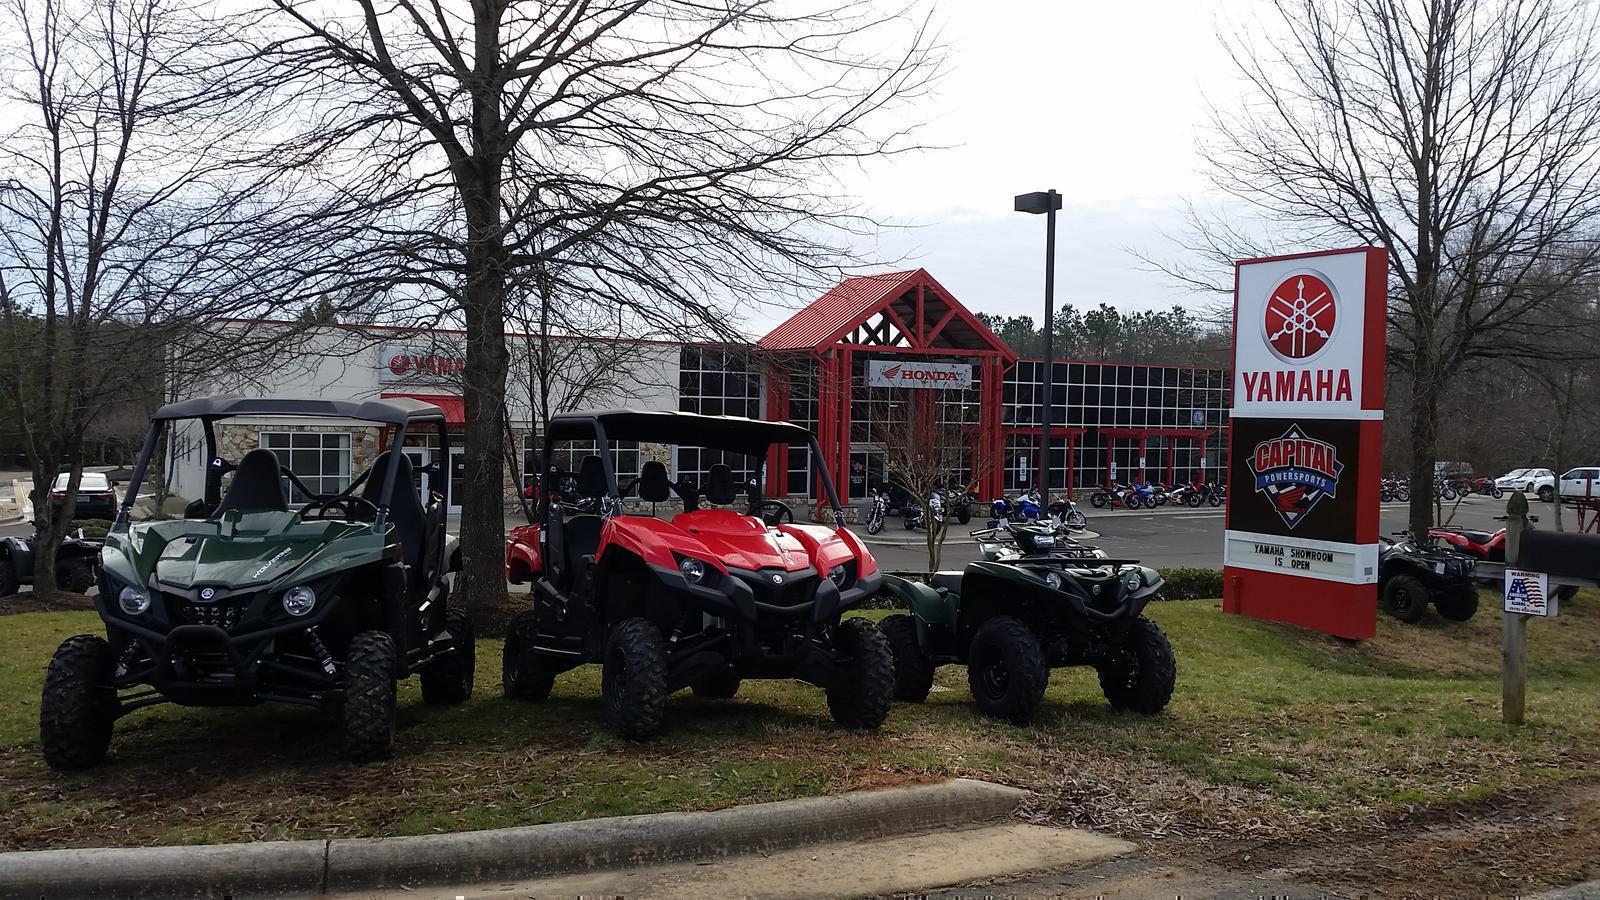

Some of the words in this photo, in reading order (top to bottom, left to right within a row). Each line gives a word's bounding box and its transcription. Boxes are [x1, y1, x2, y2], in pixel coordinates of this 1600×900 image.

[901, 370, 959, 381] HONDA
[1242, 369, 1353, 402] YAMAHA
[1254, 439, 1337, 479] CAPITAL
[1264, 472, 1327, 487] POWERSPORTS
[1254, 544, 1285, 557] YAMAHA
[1290, 548, 1334, 563] SHOWROOM
[252, 546, 293, 579] WOLVERINE
[1274, 557, 1283, 567] IS
[1291, 559, 1311, 571] OPEN
[1511, 571, 1540, 579] WARNING
